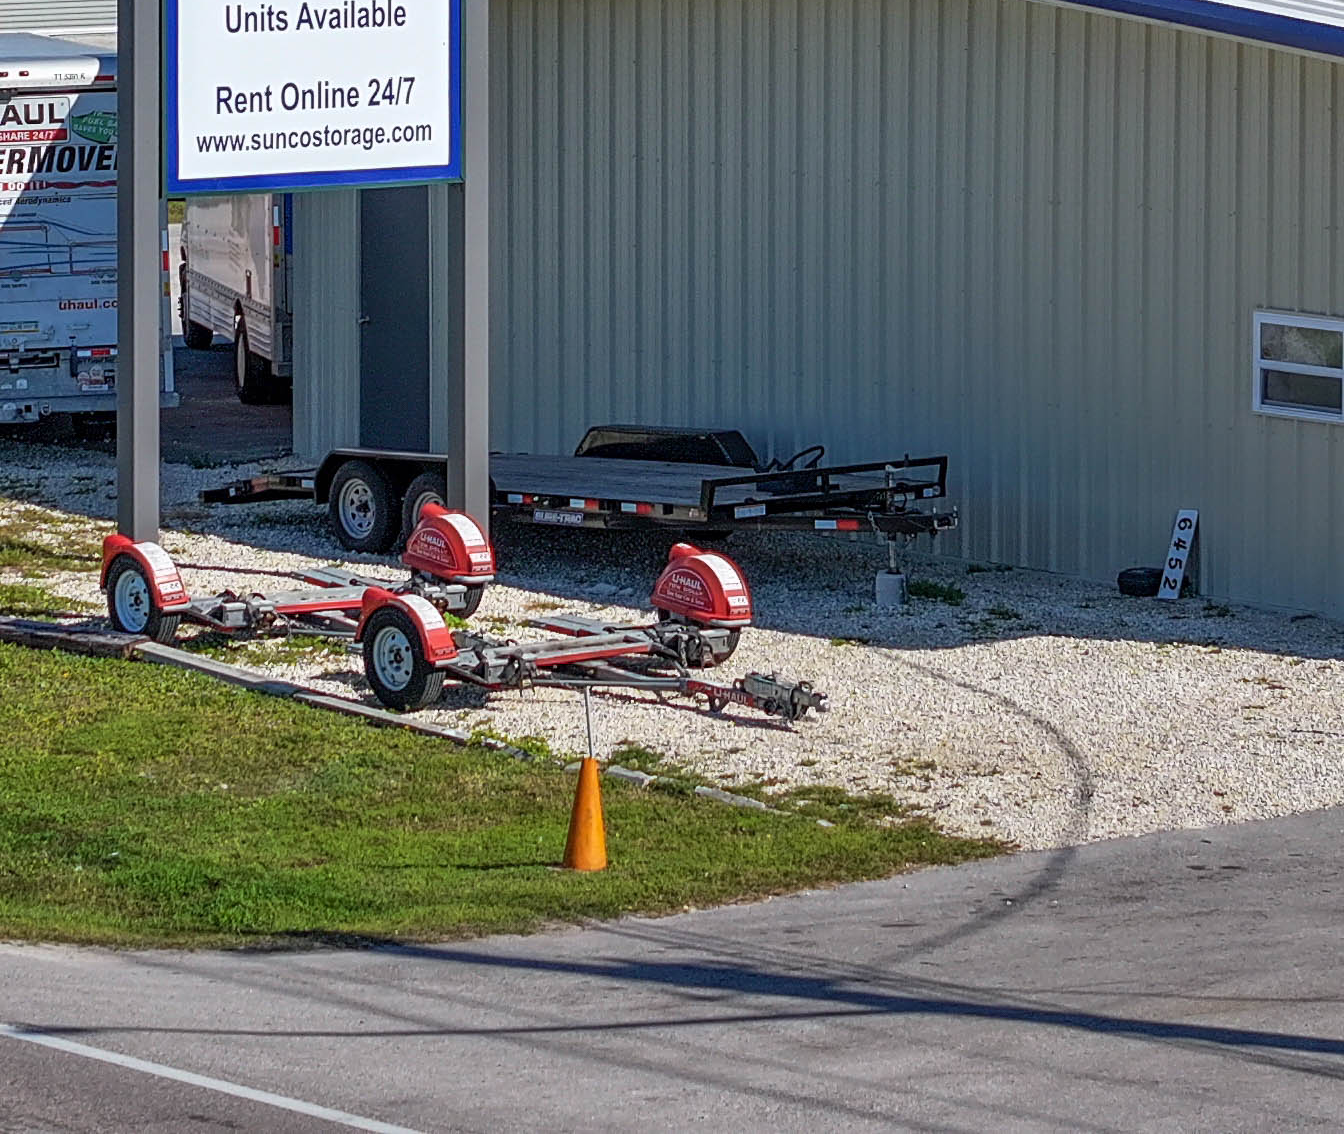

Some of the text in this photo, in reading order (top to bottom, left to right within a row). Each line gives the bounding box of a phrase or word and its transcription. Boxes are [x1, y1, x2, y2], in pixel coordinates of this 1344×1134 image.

[225, 3, 289, 33] Units
[216, 76, 416, 115] Rent Online 24/7
[32, 130, 55, 141] 24/7
[196, 122, 432, 153] www.suncostorage.com
[7, 182, 25, 191] DO
[15, 196, 72, 206] Aerodynamics
[58, 298, 118, 312] uhaul.co
[1163, 517, 1193, 591] 6452
[672, 573, 703, 591] U-HAUL
[713, 688, 749, 706] U-HAUL
